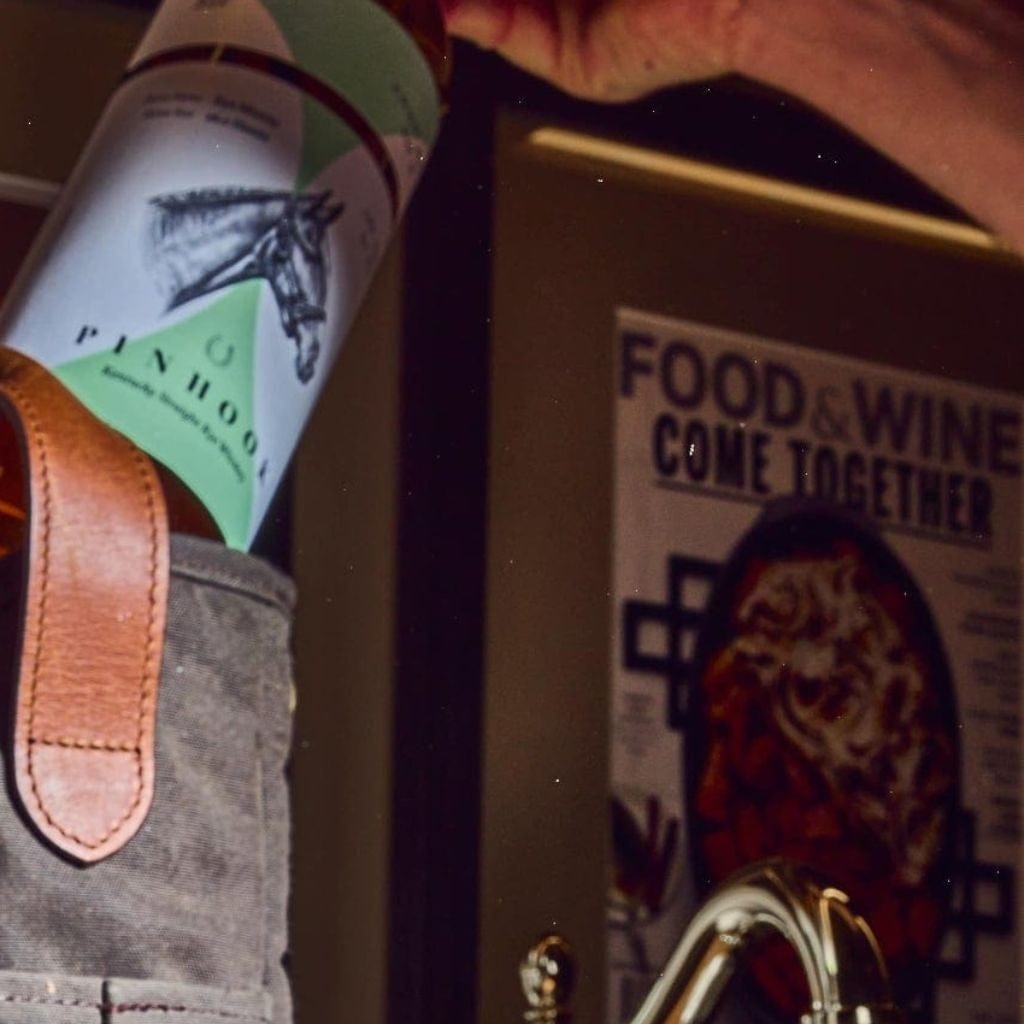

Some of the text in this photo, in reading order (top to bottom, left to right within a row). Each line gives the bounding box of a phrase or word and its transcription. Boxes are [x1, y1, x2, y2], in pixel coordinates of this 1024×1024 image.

[619, 331, 806, 428] FOOD
[852, 376, 1022, 478] WINE
[652, 412, 993, 537] COME TOGETHER
